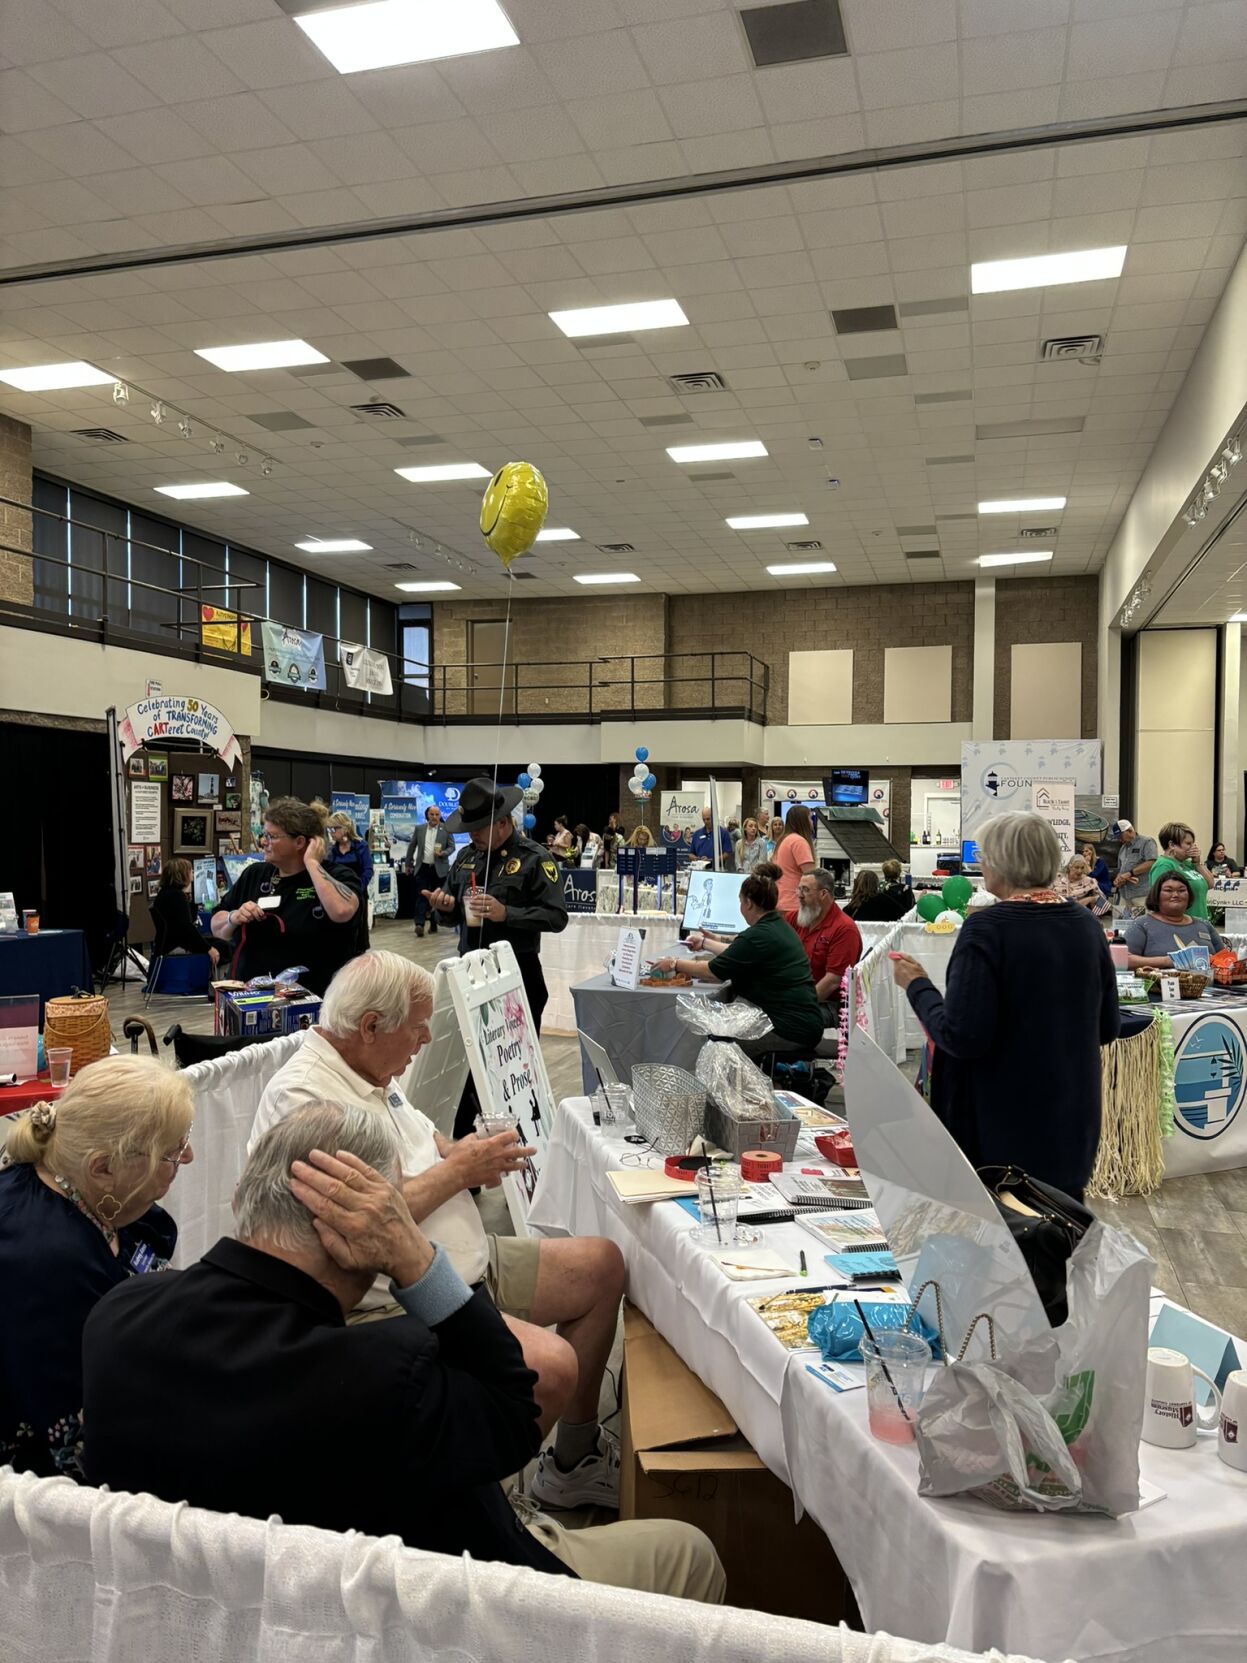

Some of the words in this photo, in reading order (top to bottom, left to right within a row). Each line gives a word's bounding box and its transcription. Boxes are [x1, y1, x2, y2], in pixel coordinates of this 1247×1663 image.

[137, 698, 185, 715] Celebrating
[187, 699, 199, 712] 50
[200, 704, 218, 724] Years
[153, 710, 161, 721] of
[166, 711, 218, 735] TRANSFORMING
[186, 724, 210, 740] County!
[1001, 780, 1032, 788] FOUN
[666, 796, 699, 816] Arosa
[483, 1025, 506, 1046] Literary
[497, 1040, 523, 1067] Poetry
[503, 1079, 511, 1102] &
[510, 1069, 532, 1096] Prose
[1151, 1403, 1179, 1413] Museum
[1154, 1409, 1180, 1419] History
